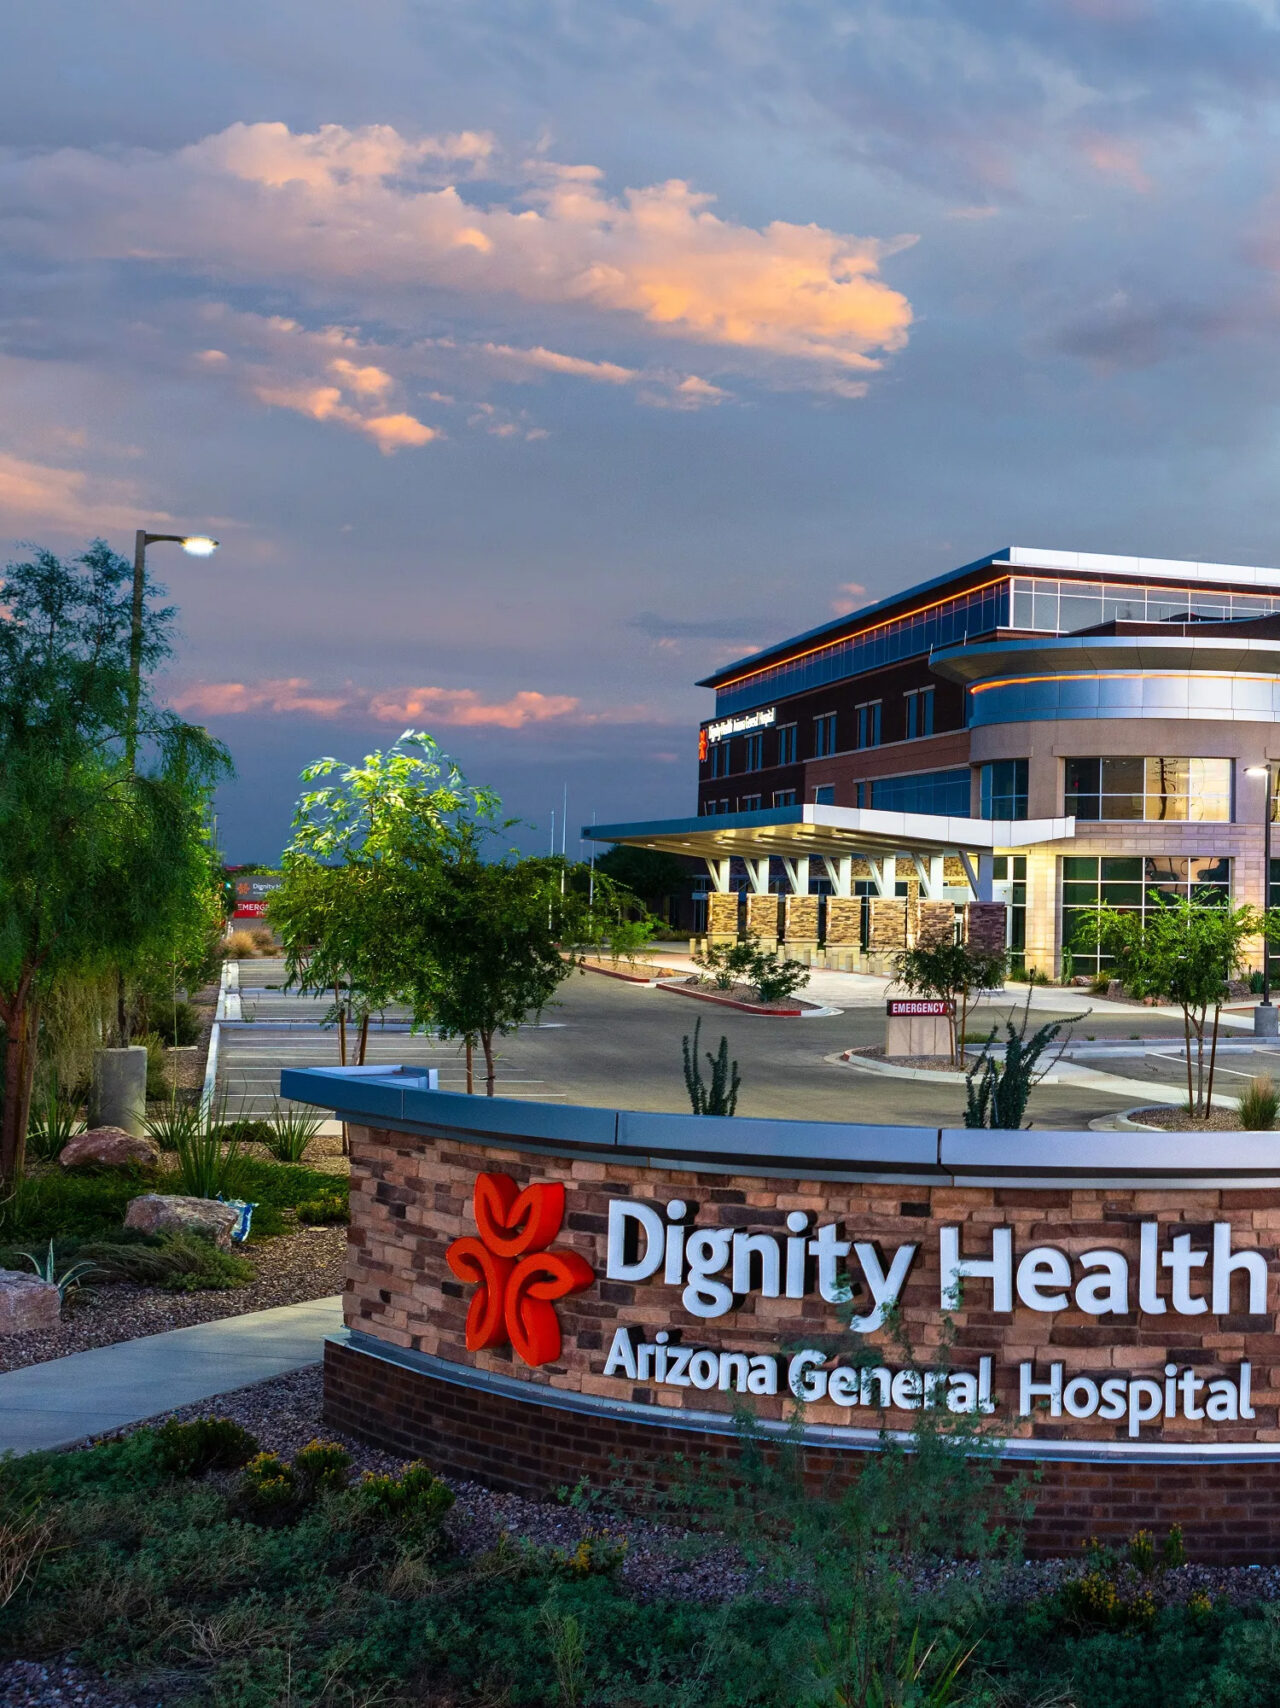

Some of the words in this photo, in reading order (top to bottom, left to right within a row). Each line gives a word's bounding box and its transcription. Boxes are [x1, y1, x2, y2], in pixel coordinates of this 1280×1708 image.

[252, 883, 276, 891] Dignity
[892, 1002, 945, 1013] EMERGENCY
[606, 1199, 919, 1334] Dignity
[939, 1222, 1268, 1315] Health
[603, 1327, 778, 1395] Arizona
[787, 1349, 995, 1414] General
[1019, 1361, 1256, 1437] Hospital
